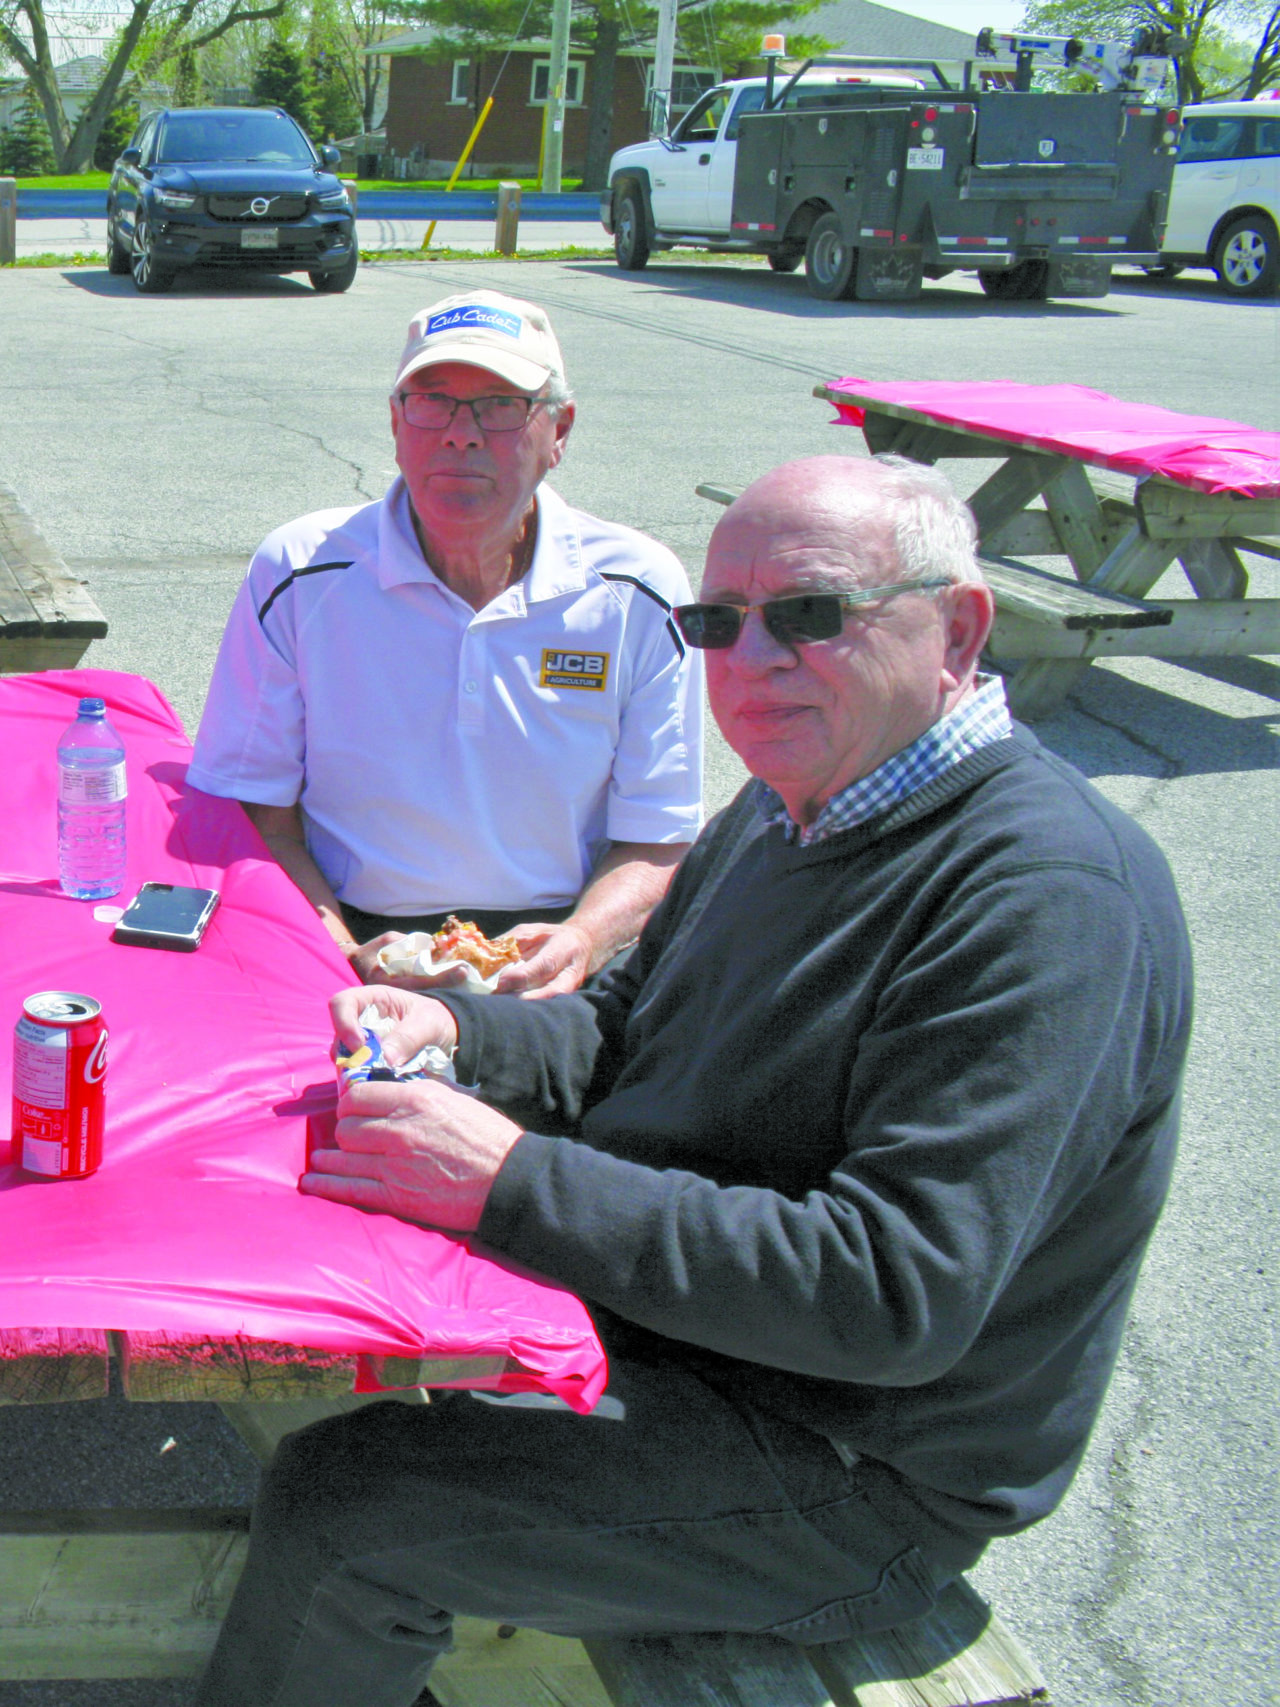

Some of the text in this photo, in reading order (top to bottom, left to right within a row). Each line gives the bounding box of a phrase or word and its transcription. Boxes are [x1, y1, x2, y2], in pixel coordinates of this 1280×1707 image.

[431, 309, 518, 333] Cub Cadet
[546, 653, 604, 674] JCB
